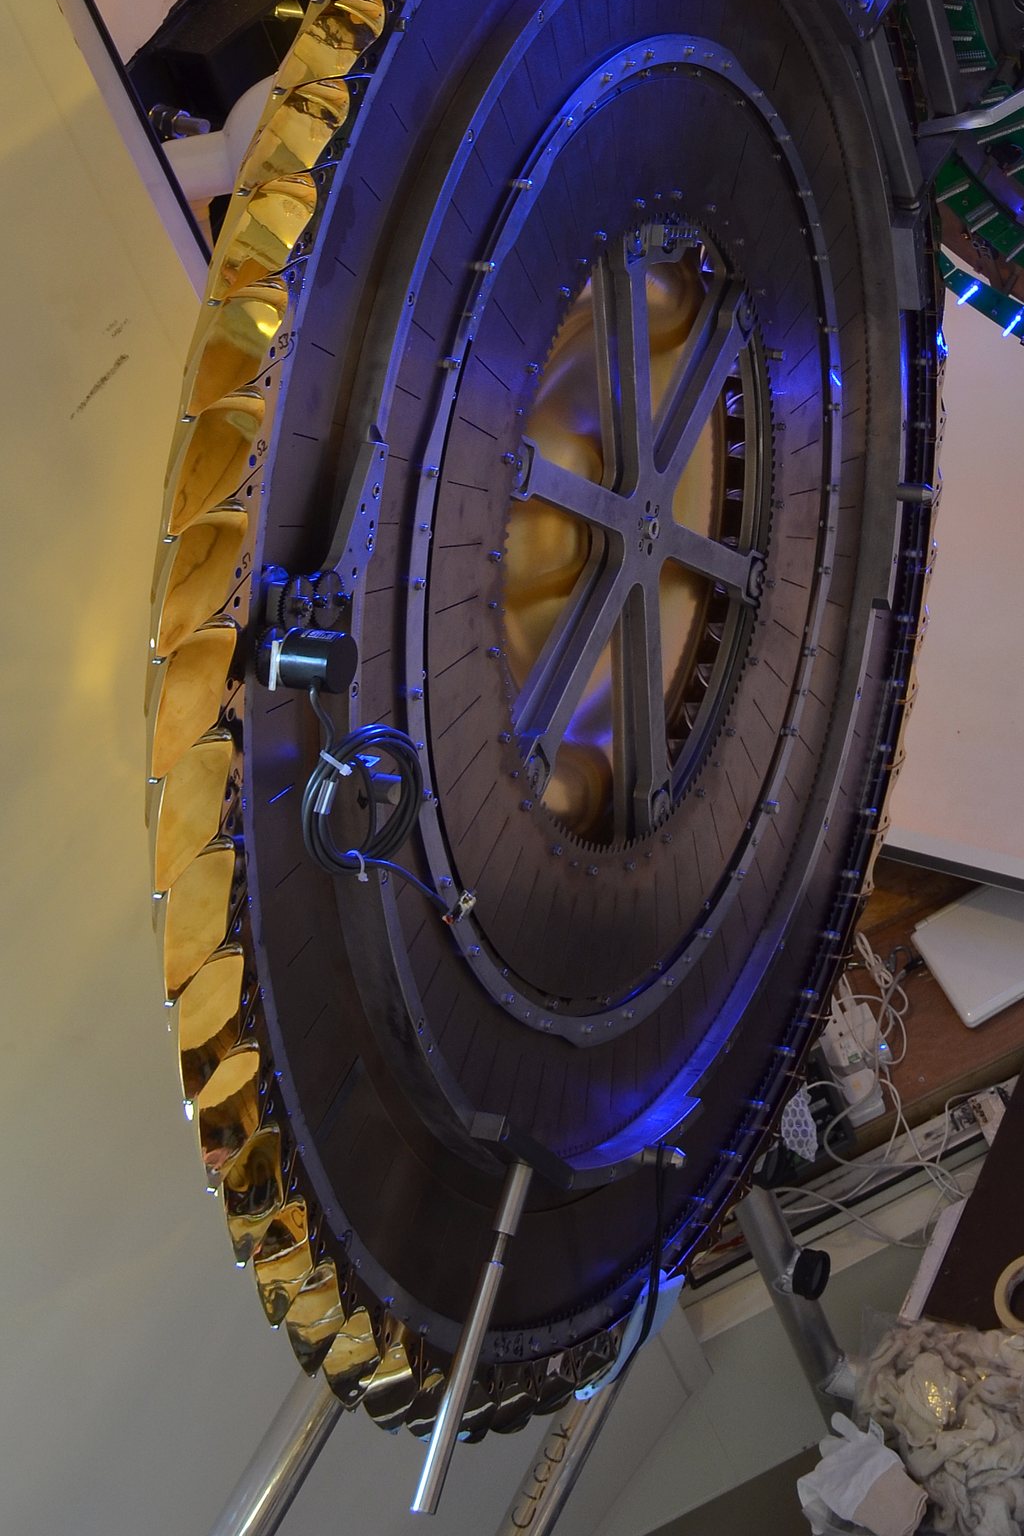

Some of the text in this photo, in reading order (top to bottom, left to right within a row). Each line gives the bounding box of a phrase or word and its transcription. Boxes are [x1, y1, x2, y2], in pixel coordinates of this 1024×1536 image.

[278, 332, 289, 350] 53
[256, 438, 269, 457] 52
[510, 1423, 572, 1530] CLOCK
